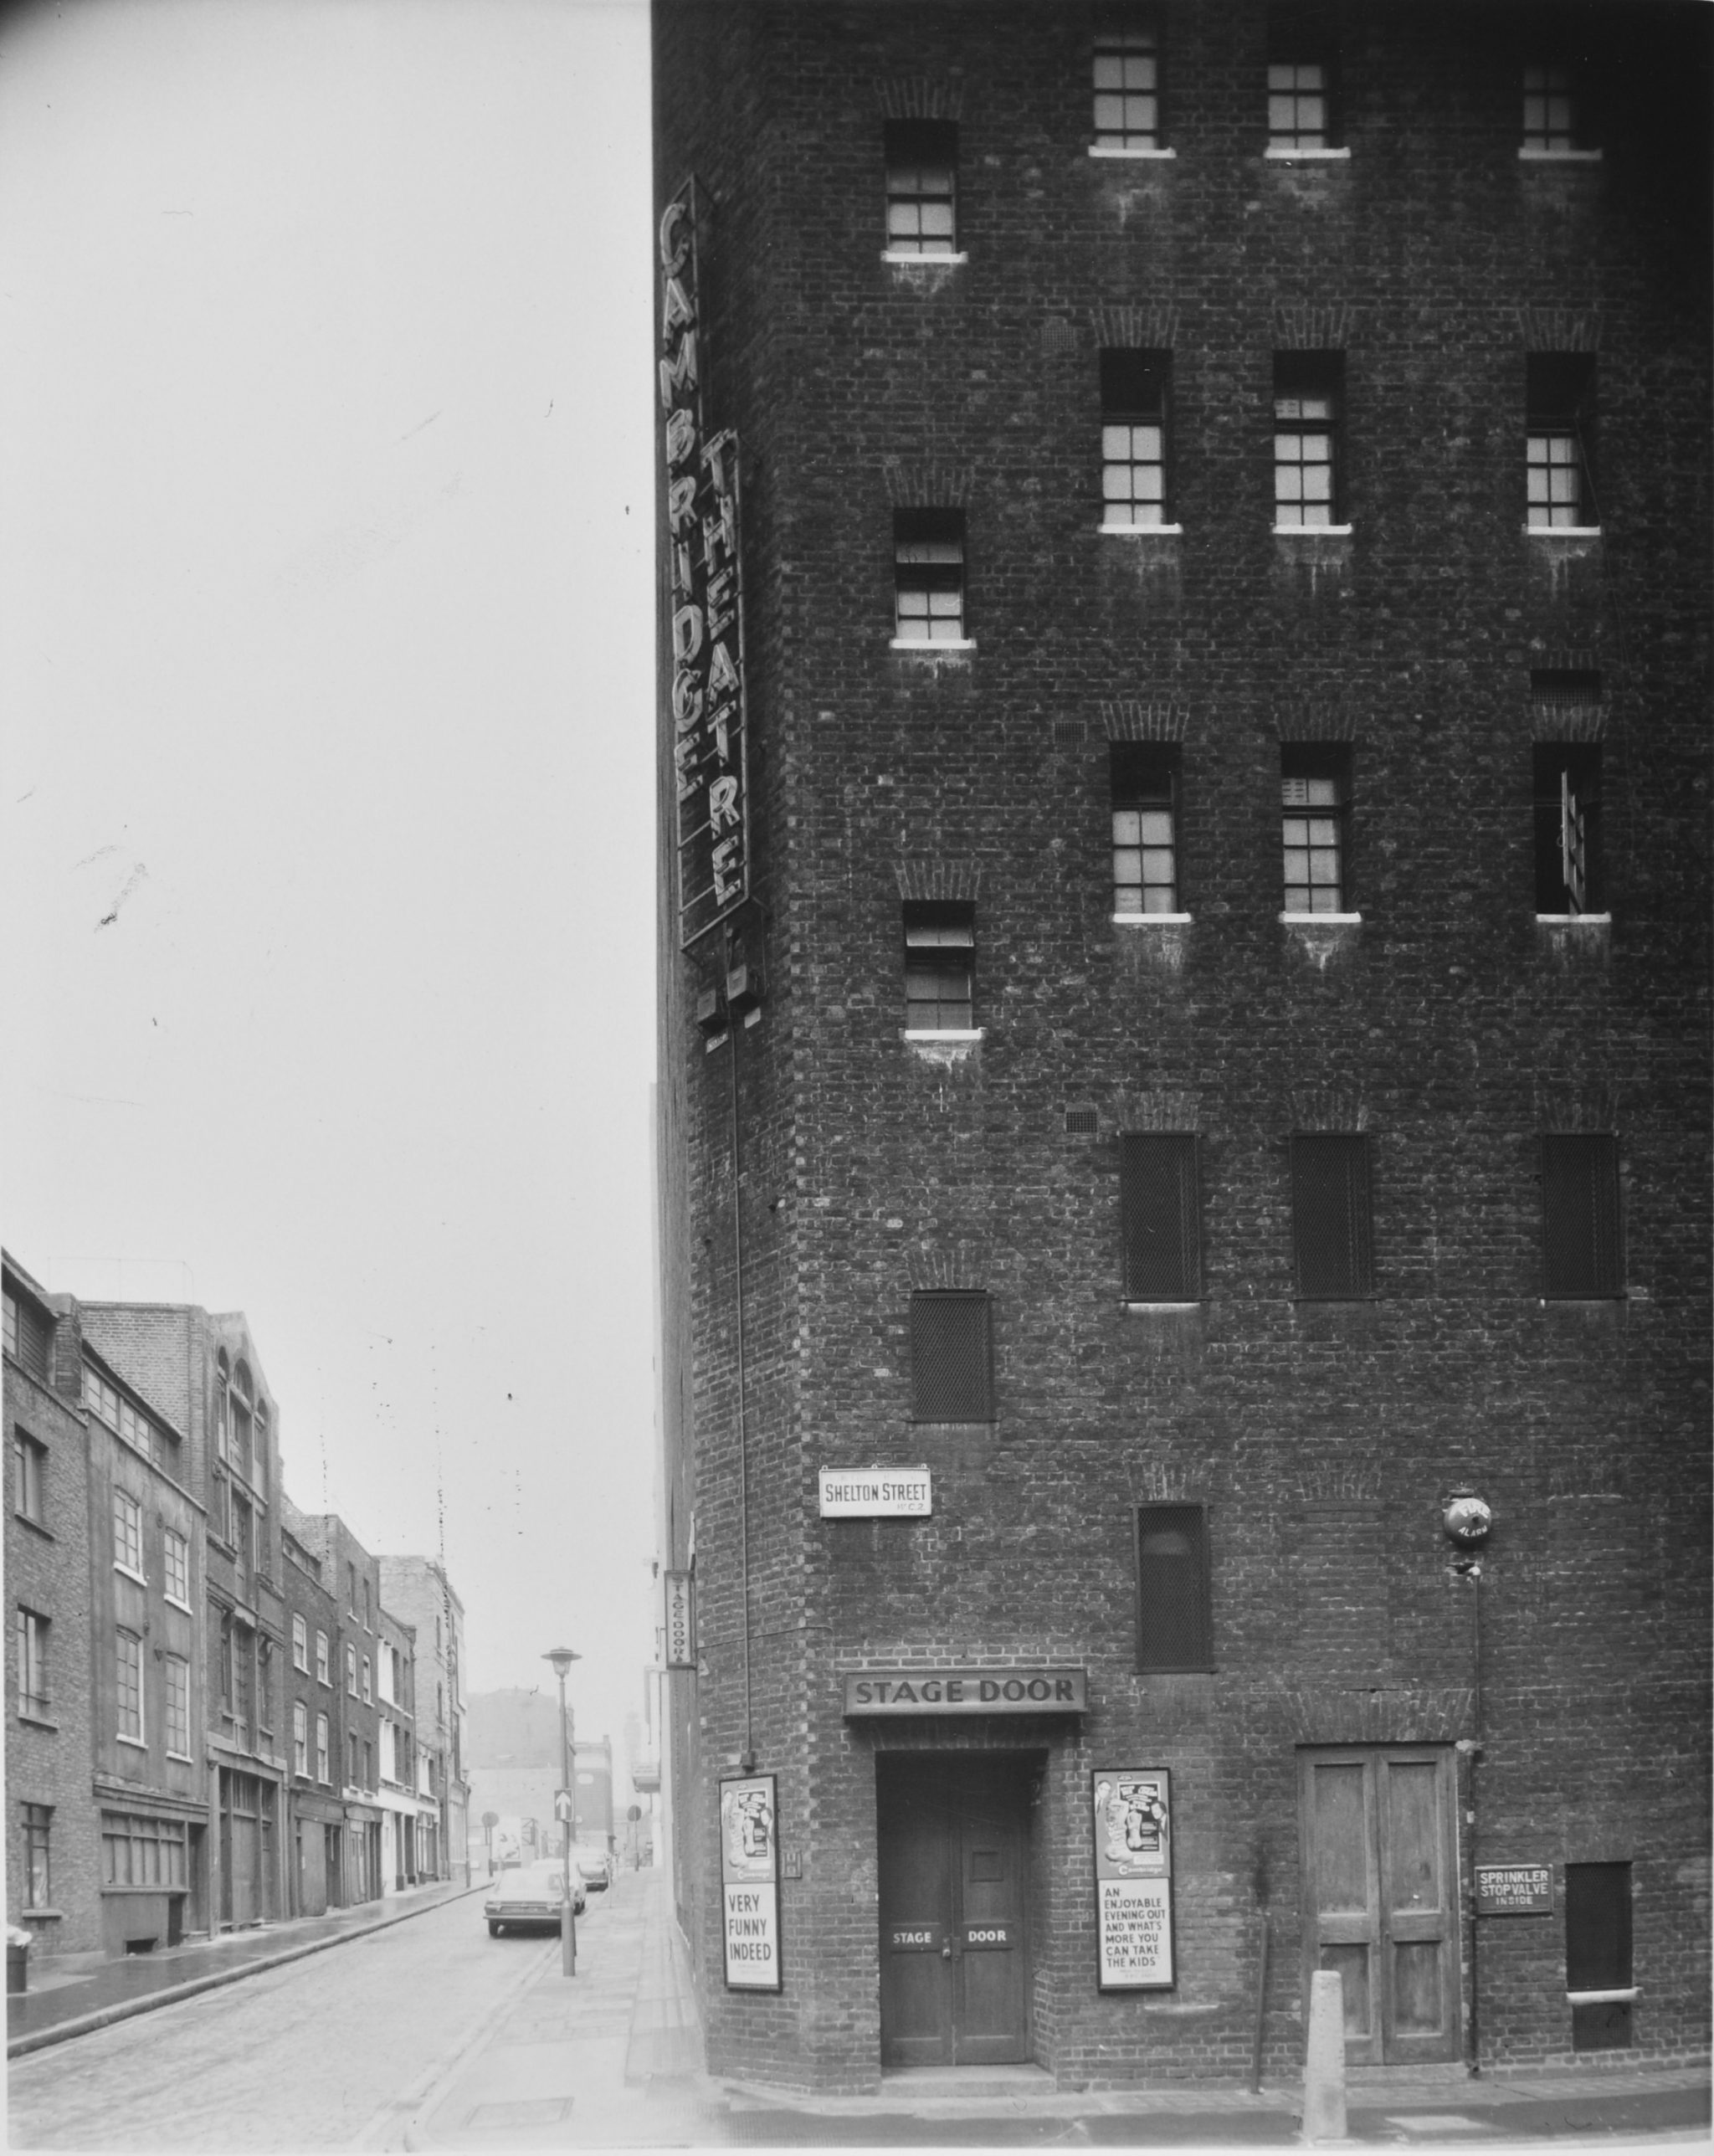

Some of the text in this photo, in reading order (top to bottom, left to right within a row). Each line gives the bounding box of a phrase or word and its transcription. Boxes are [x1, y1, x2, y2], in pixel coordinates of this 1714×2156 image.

[659, 203, 703, 802] CAMBRIDGE
[700, 429, 742, 906] THEATRE
[825, 1483, 926, 1502] SHELTON STREET
[1458, 1502, 1491, 1518] FIRE
[1458, 1525, 1488, 1537] ALARM
[672, 1577, 685, 1655] STAGE DOOR
[856, 1678, 1075, 1704] STAGE DOOR
[1480, 1870, 1549, 1885] SPRINKLER
[1105, 1887, 1121, 1897] AN
[1481, 1882, 1548, 1897] STOP VALVE
[728, 1894, 760, 1912] VERY
[1105, 1897, 1162, 1909] ENJOYABLE
[1496, 1896, 1533, 1906] INSIDE
[1105, 1909, 1166, 1921] EVENING OUT
[729, 1918, 767, 1936] FUNNY
[1106, 1921, 1162, 1932] AND WHAT'S
[893, 1932, 932, 1943] STAGE
[967, 1930, 1007, 1943] DOOR
[1106, 1933, 1159, 1944] MORE YOU
[730, 1943, 772, 1961] INDEED
[1106, 1944, 1159, 1956] CAN TAKE
[1106, 1957, 1156, 1968] THE KIDS
